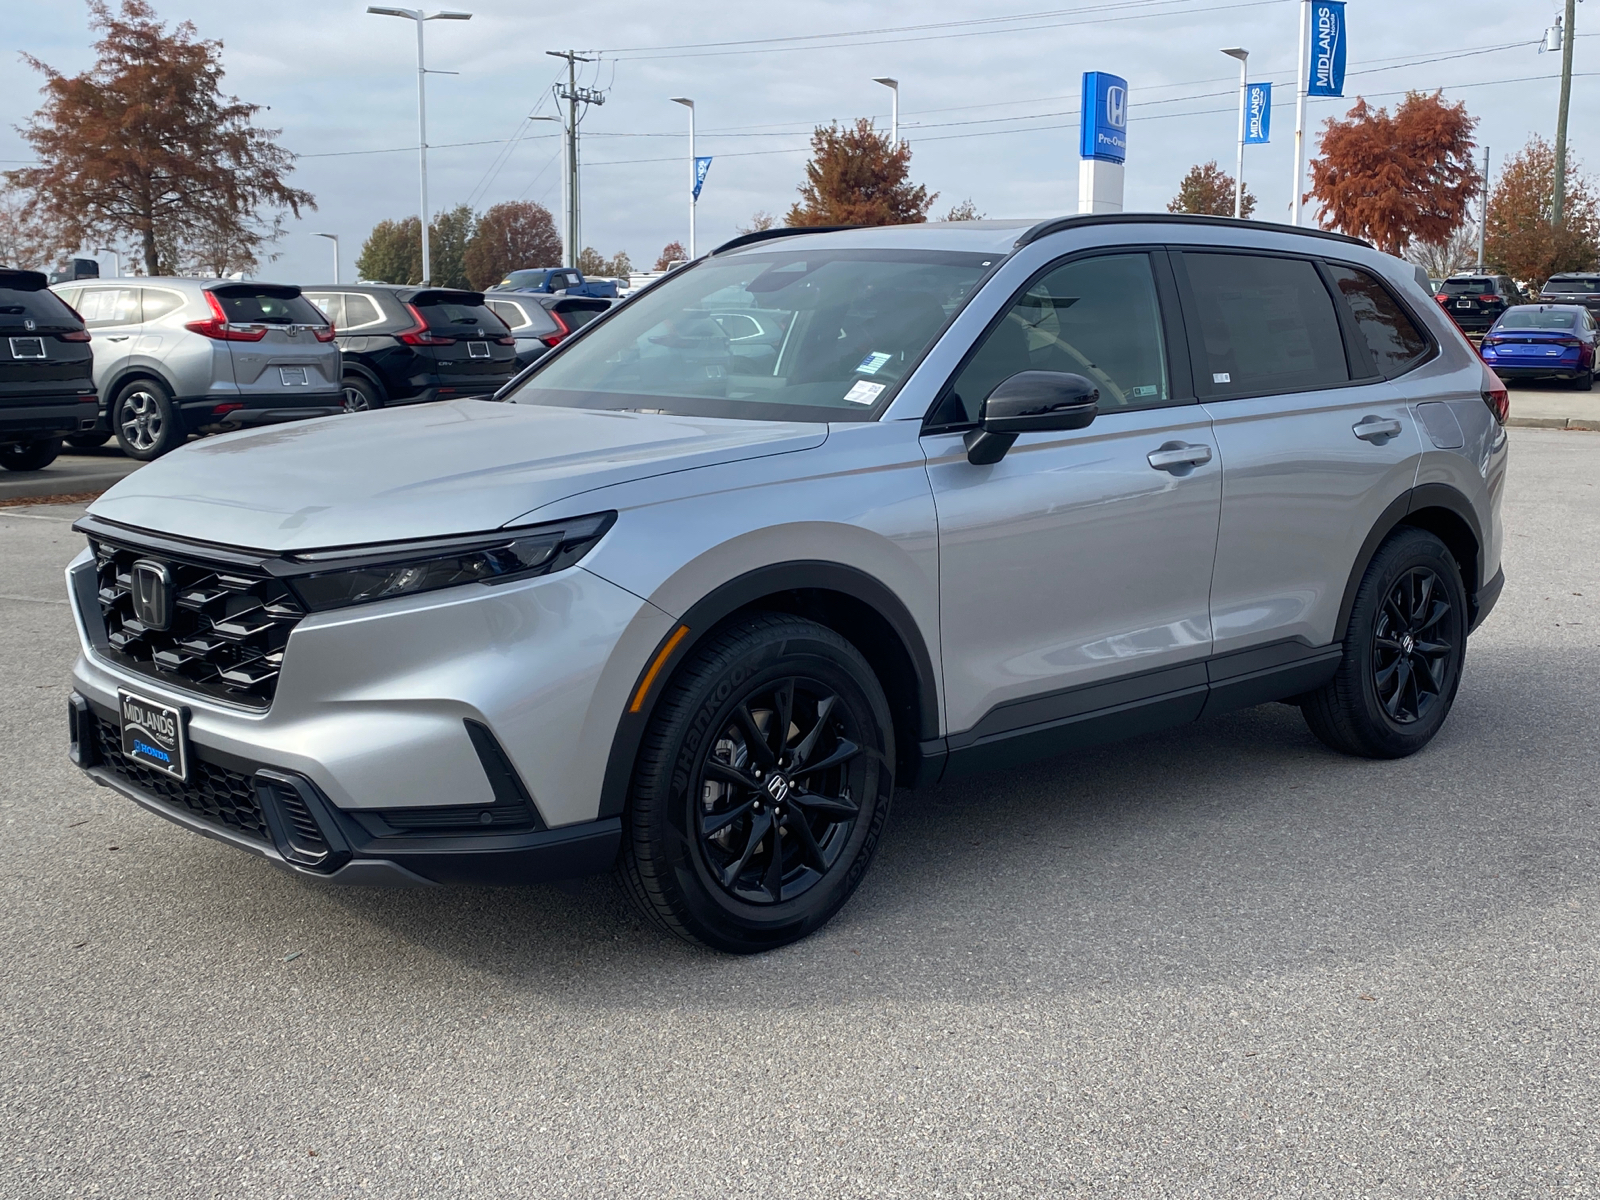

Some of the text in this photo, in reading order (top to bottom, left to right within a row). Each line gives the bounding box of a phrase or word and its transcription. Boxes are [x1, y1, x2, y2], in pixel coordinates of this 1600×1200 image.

[1316, 7, 1331, 87] MIDLANDS
[1250, 87, 1260, 138] MIDLANDS
[123, 701, 175, 737] MIDLANDS
[140, 743, 170, 763] HONDA
